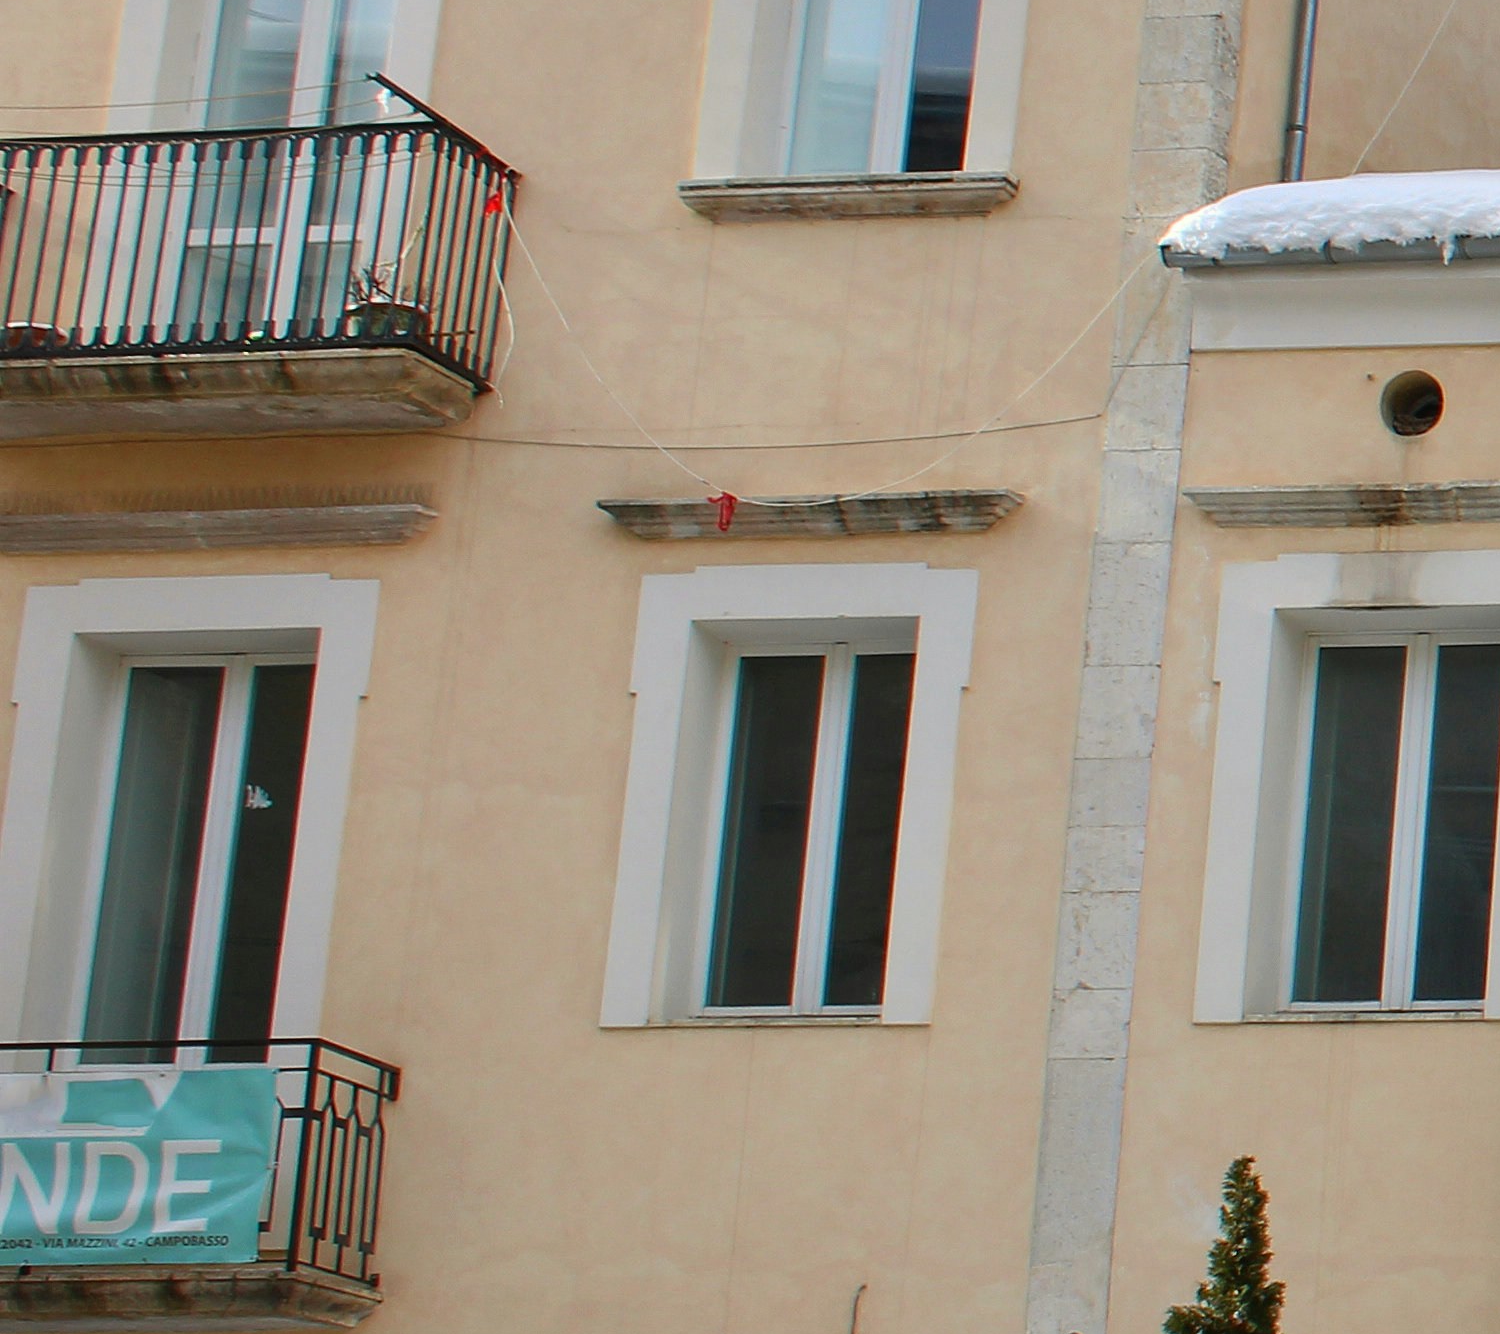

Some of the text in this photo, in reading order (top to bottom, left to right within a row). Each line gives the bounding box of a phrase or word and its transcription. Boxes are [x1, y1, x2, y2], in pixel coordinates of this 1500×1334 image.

[0, 1139, 223, 1235] NDE
[42, 1238, 65, 1249] VIA
[144, 1235, 229, 1248] CAMPOBASSO
